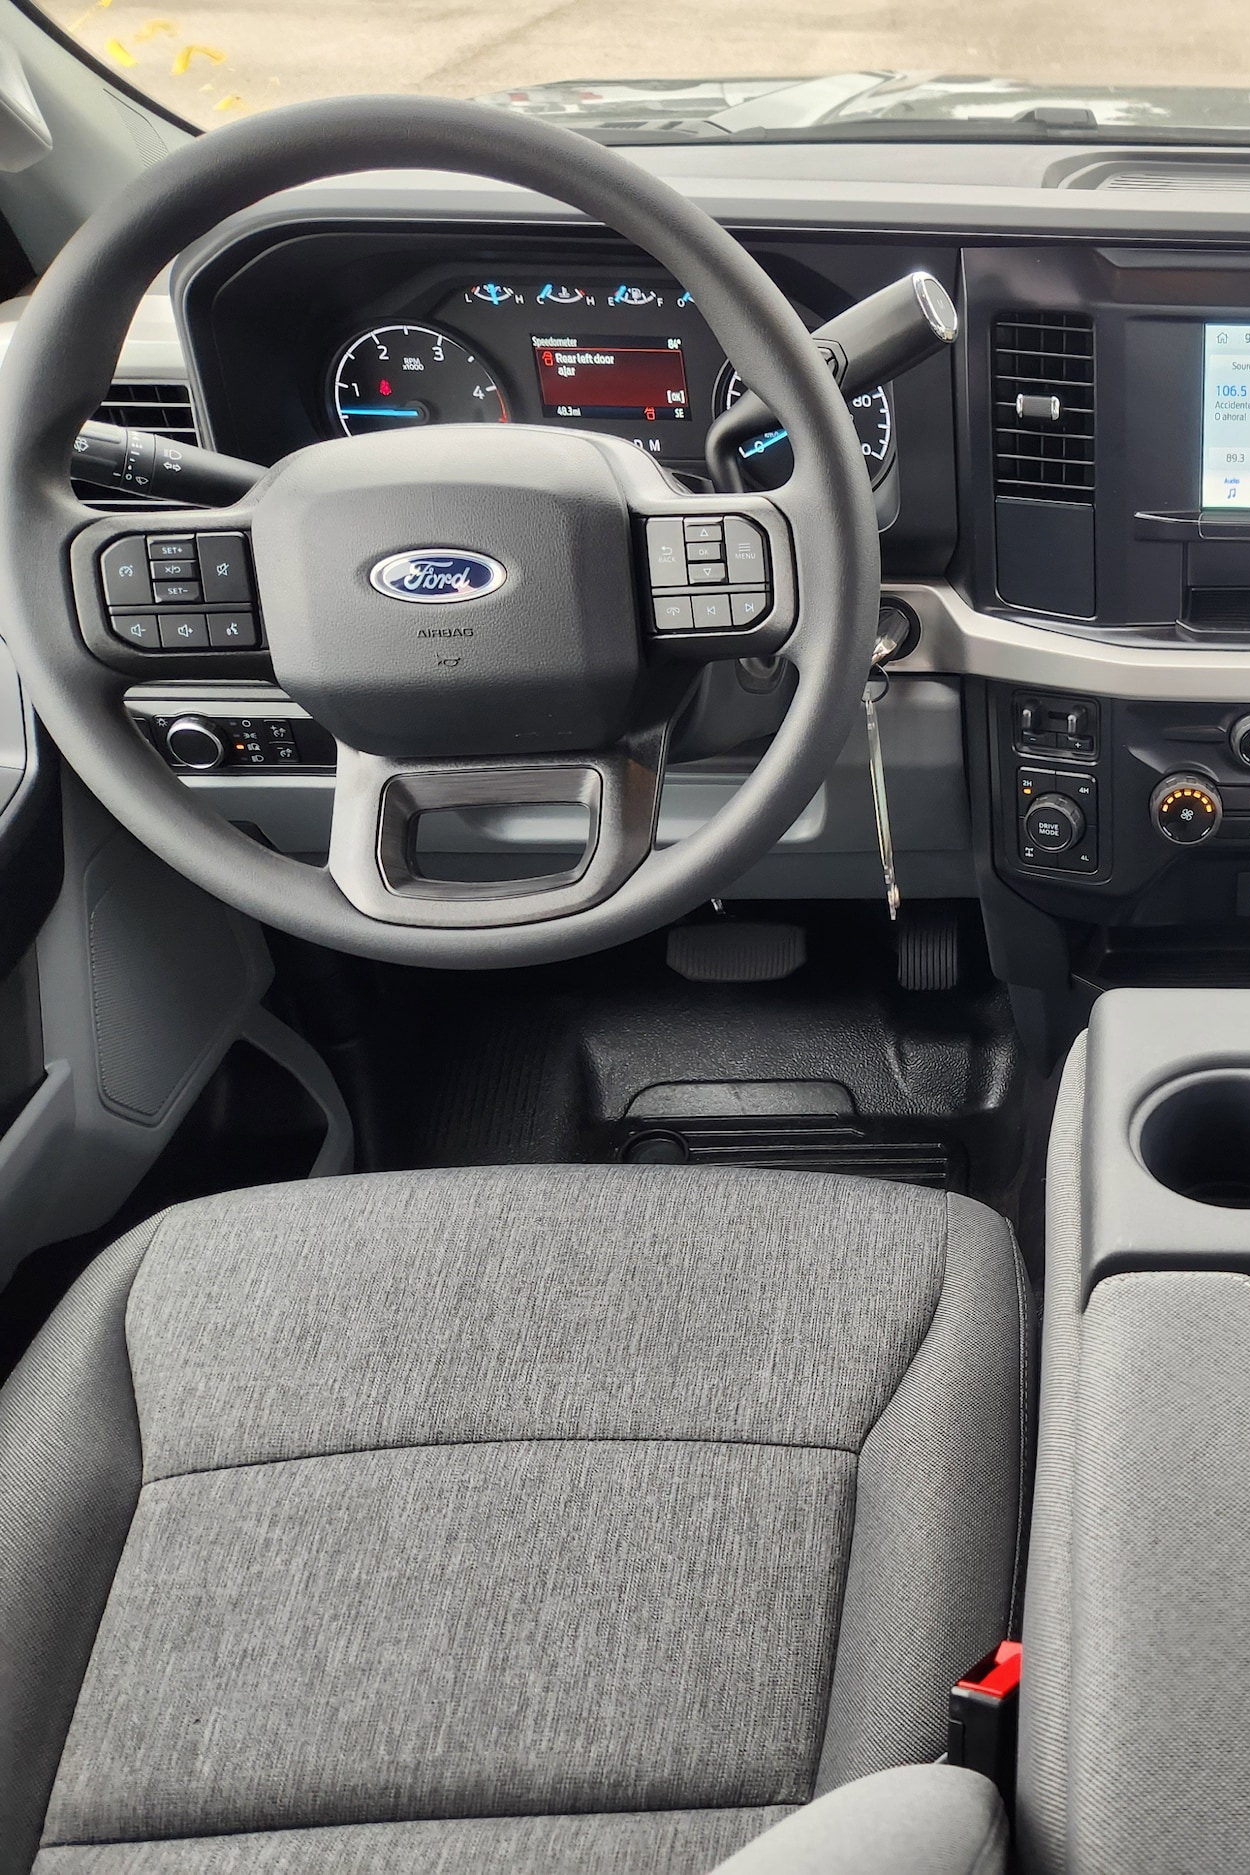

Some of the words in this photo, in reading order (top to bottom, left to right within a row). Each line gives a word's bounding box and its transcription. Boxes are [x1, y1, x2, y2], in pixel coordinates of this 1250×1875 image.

[464, 293, 473, 303] L
[514, 294, 524, 305] H
[586, 296, 596, 307] H
[607, 296, 615, 307] E
[656, 297, 664, 308] F
[531, 336, 577, 348] Speedometer
[376, 345, 390, 360] 2
[431, 346, 445, 361] 3
[555, 353, 576, 364] Rear
[576, 353, 593, 365] left
[593, 354, 615, 365] door
[557, 365, 576, 377] ajar
[351, 382, 360, 397] 1
[472, 385, 485, 400] 4
[1216, 385, 1247, 397] 106.5
[674, 408, 685, 418] SE
[1222, 412, 1247, 421] ahora!
[649, 439, 661, 452] M
[1225, 453, 1245, 463] 89.3
[1224, 477, 1240, 485] Audio
[698, 548, 710, 556] OK
[403, 560, 471, 591] Ford
[417, 628, 474, 639] AIRBAG
[1038, 822, 1059, 831] DRIVE
[1038, 828, 1060, 837] MODE
